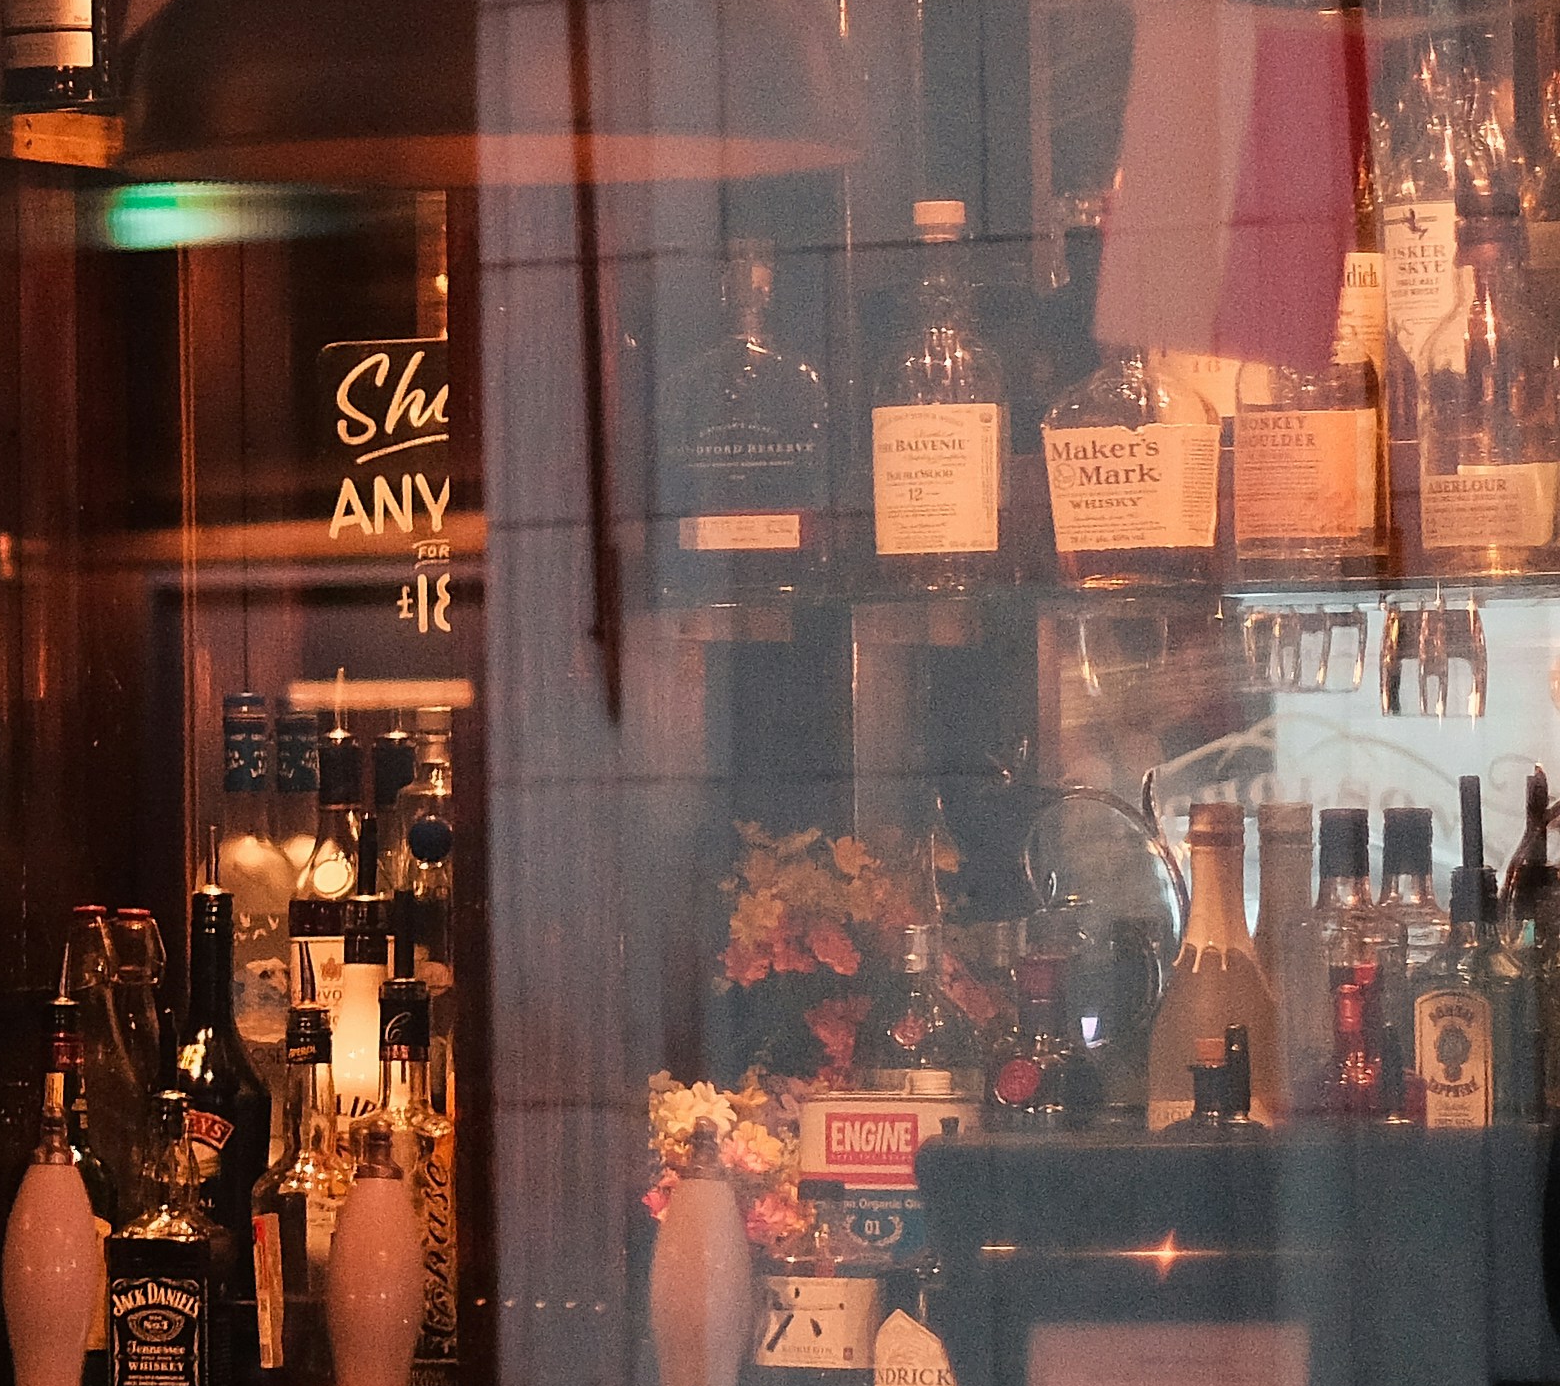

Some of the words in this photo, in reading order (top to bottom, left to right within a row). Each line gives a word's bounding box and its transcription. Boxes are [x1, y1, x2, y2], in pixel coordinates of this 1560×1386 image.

[1050, 437, 1162, 463] Maker's
[1079, 461, 1161, 487] Mark
[328, 473, 451, 540] ANY
[1069, 496, 1143, 510] WHISKY
[417, 544, 451, 560] FOR
[830, 1119, 915, 1154] ENGINE
[863, 1219, 881, 1235] 01
[110, 1291, 146, 1319] JACK
[127, 1361, 185, 1372] WHISKEY
